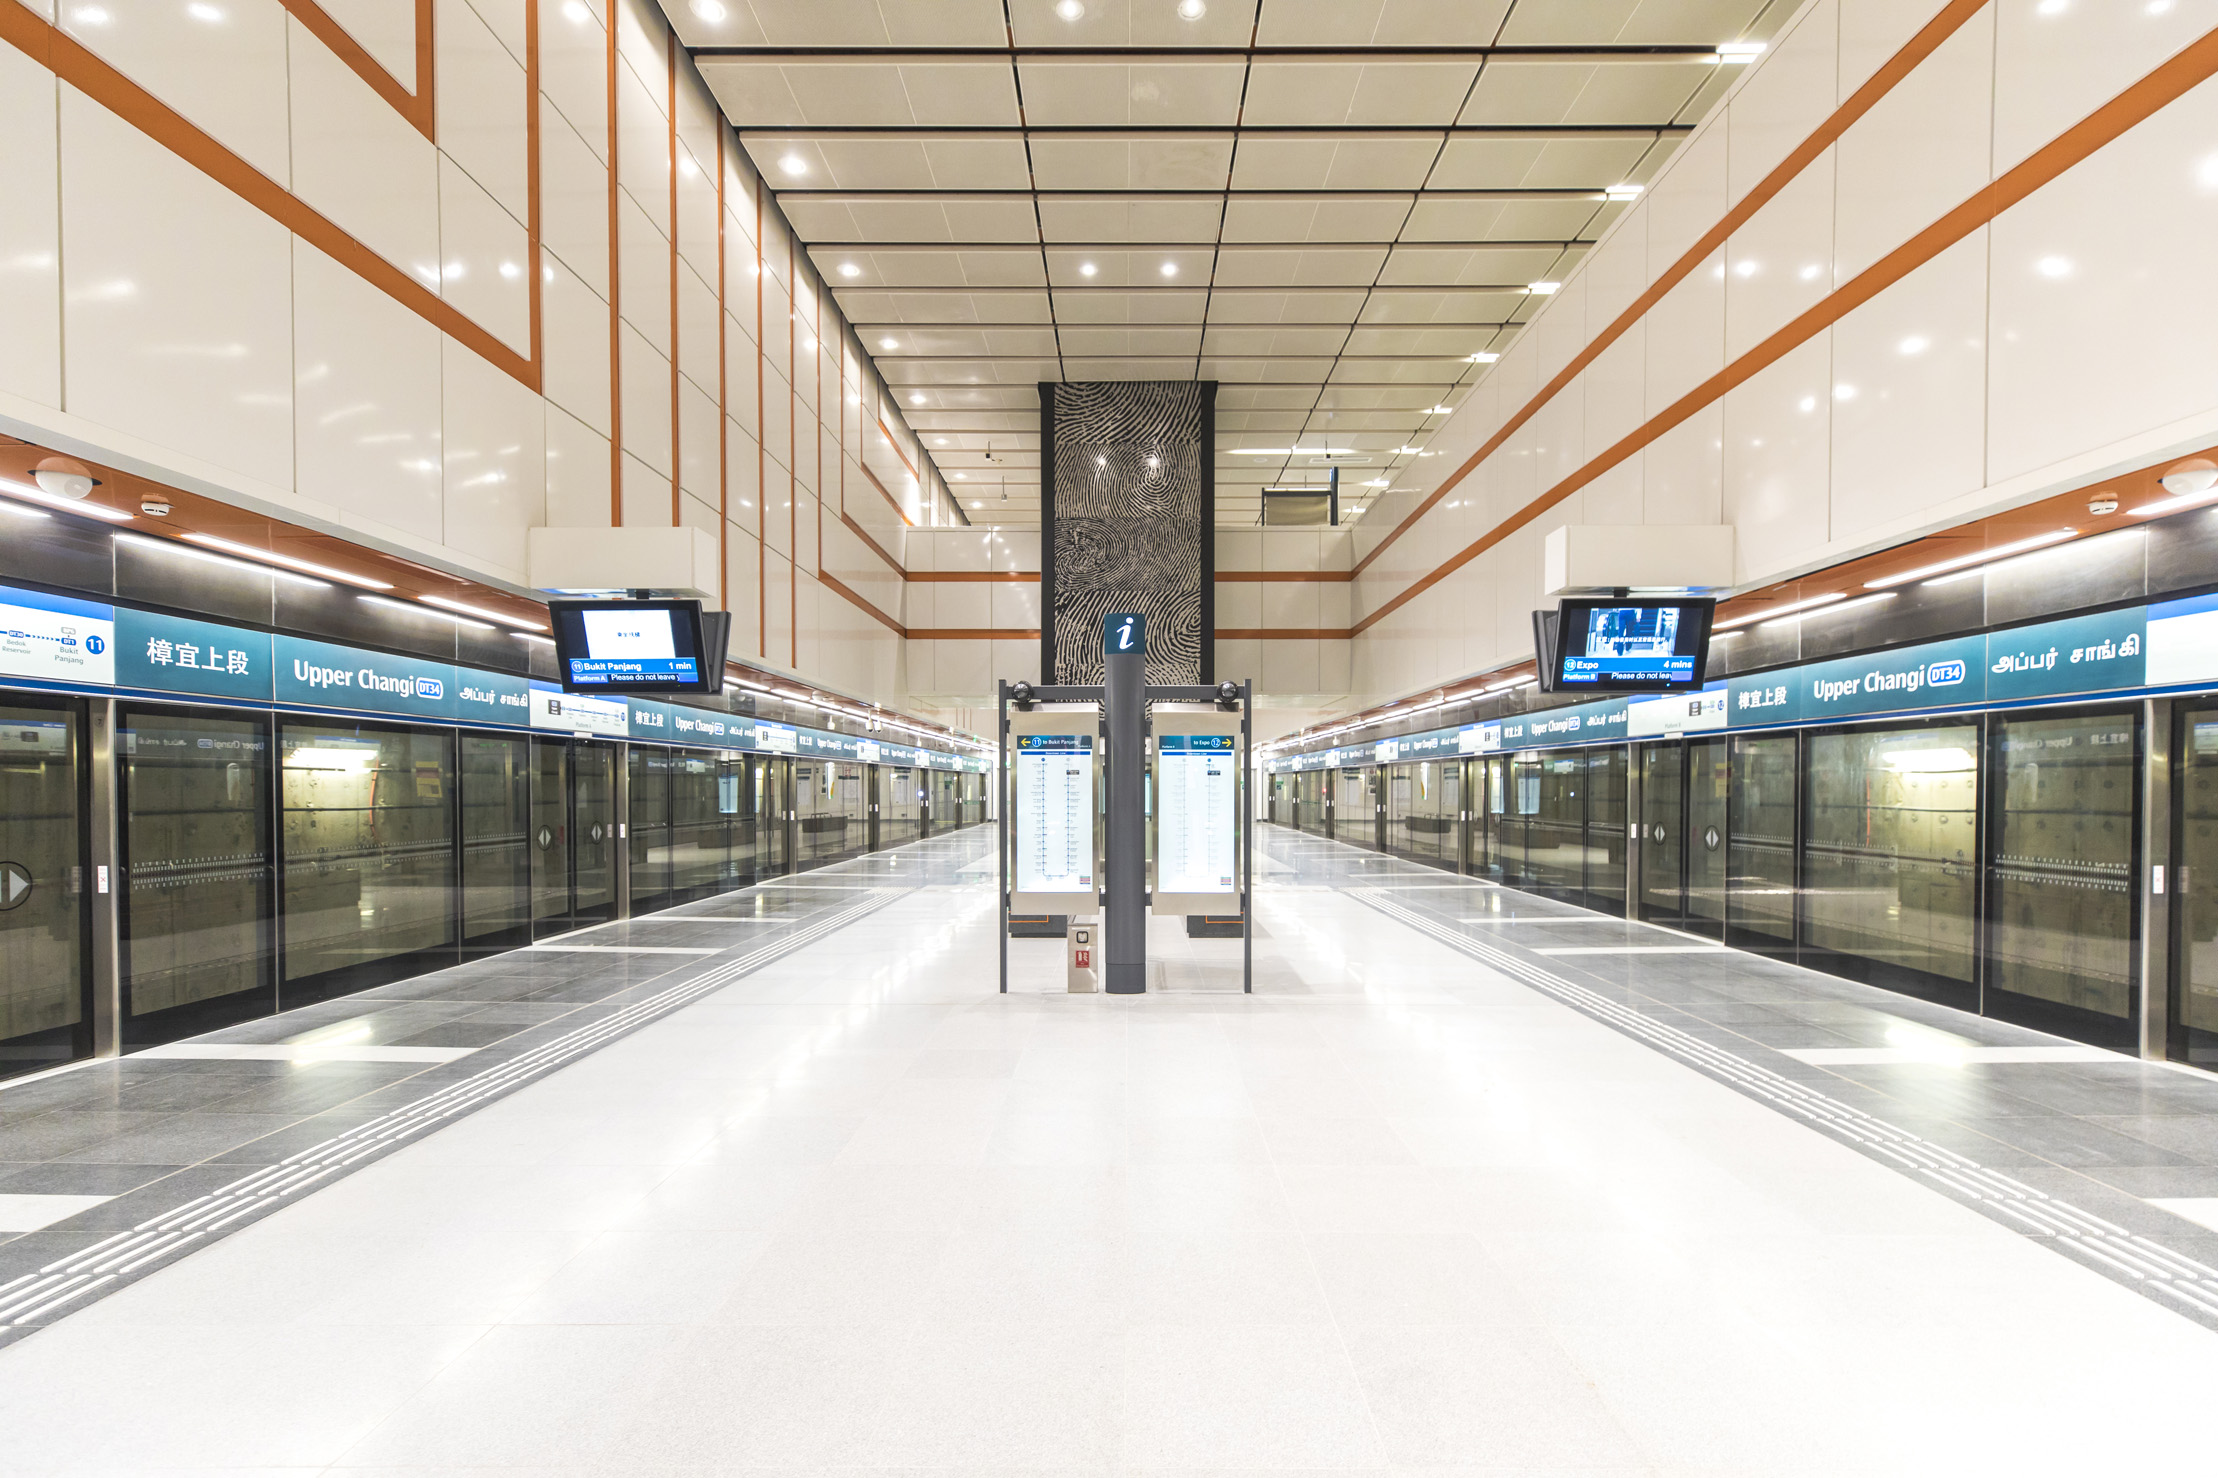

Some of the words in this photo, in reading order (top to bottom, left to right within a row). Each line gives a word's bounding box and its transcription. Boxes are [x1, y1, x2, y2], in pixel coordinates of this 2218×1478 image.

[59, 646, 79, 655] Bukit
[87, 638, 103, 652] 11
[54, 654, 84, 666] Panjang
[146, 636, 249, 676] 樟宜上段
[1991, 646, 2059, 674] அப்பர்
[2069, 632, 2140, 664] சாங்கி
[573, 662, 582, 670] 11
[583, 662, 606, 671] Bukit
[607, 662, 642, 672] Panjang
[668, 661, 673, 670] 1
[675, 661, 692, 670] min
[1566, 661, 1575, 669] 12
[1576, 661, 1599, 671] Expo
[1663, 660, 1670, 669] 4
[1671, 660, 1692, 669] mins
[294, 659, 354, 688] Upper
[357, 668, 415, 698] Changi
[418, 680, 441, 696] DT34
[611, 673, 634, 681] Please
[657, 673, 676, 681] leave
[1611, 671, 1635, 680] Please
[1636, 672, 1646, 680] do
[1646, 672, 1659, 680] not
[1813, 679, 1861, 702] Upper
[1864, 664, 1925, 693] Changi
[1931, 665, 1961, 682] DT34
[459, 686, 496, 706] அப்பர்
[500, 692, 529, 708] சாங்கி
[1737, 686, 1788, 710] 樟宜上段
[675, 716, 695, 732] Upper
[695, 719, 714, 736] Changi
[1531, 722, 1548, 737] Upper
[1547, 717, 1569, 733] Changi
[1060, 739, 1079, 747] Panjang
[1199, 739, 1211, 747] Expo
